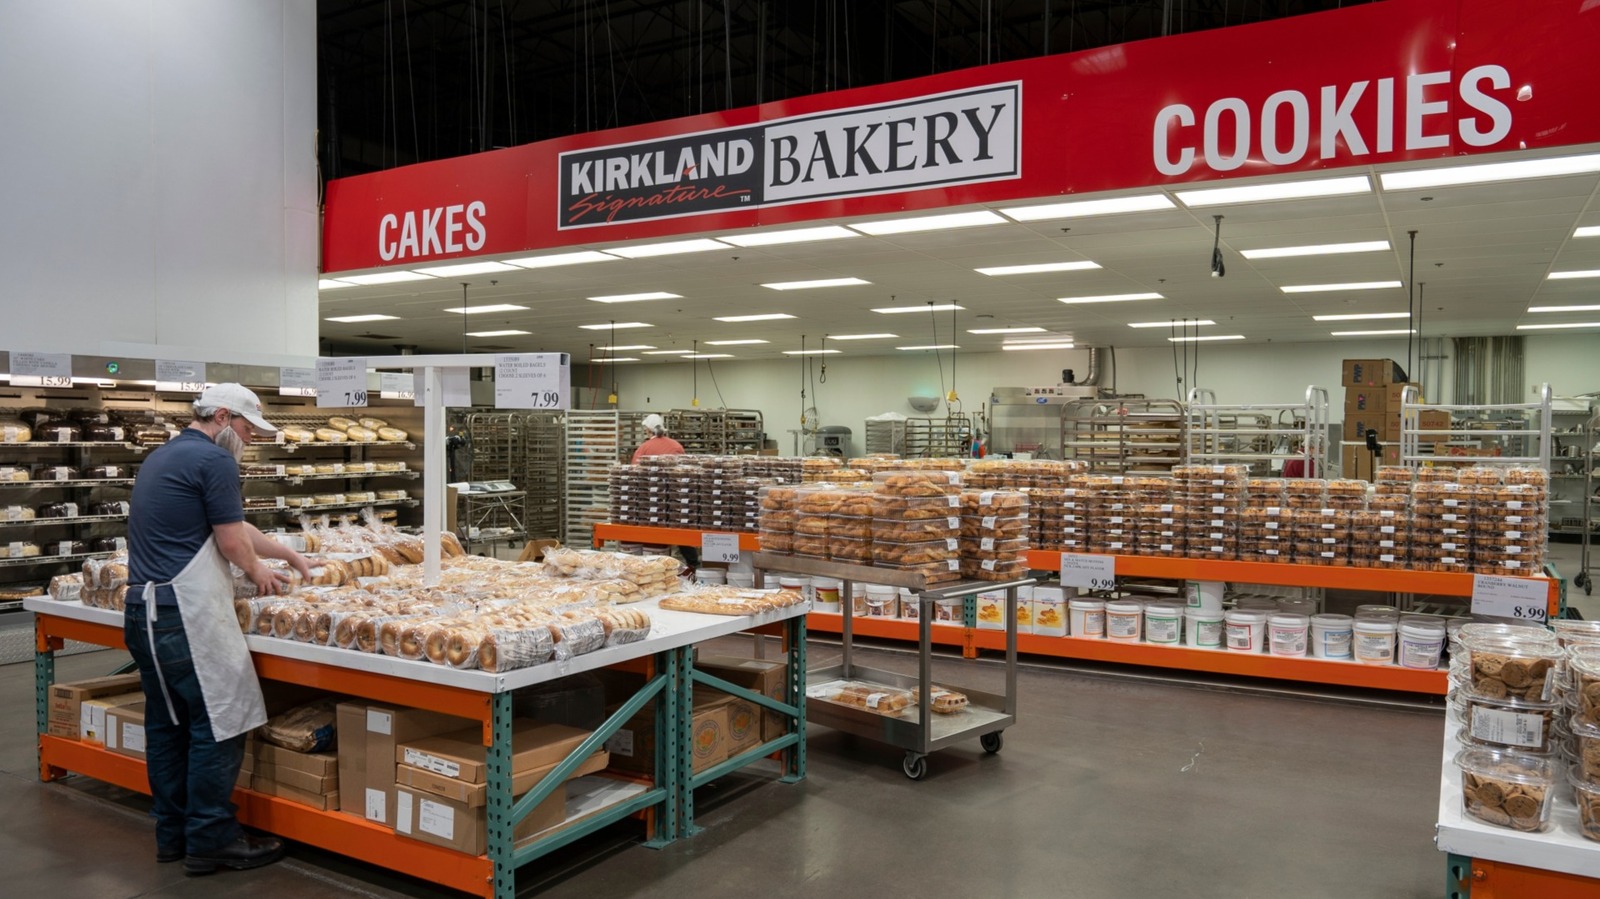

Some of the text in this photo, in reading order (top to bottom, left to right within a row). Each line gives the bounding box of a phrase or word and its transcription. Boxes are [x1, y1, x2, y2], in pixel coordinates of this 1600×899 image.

[1153, 64, 1512, 175] COOKIES
[769, 104, 1006, 187] BAKERY
[570, 139, 755, 195] KIRKLAND
[569, 184, 750, 223] Signature
[379, 200, 486, 261] CAKES
[40, 375, 71, 387] 15.99
[180, 381, 206, 391] 15.99
[300, 387, 317, 397] 16.9
[344, 391, 367, 406] 7.99
[531, 392, 559, 408] 7.99
[722, 553, 739, 562] 9.99
[1091, 578, 1114, 589] 9.99
[1514, 606, 1545, 619] 8.99
